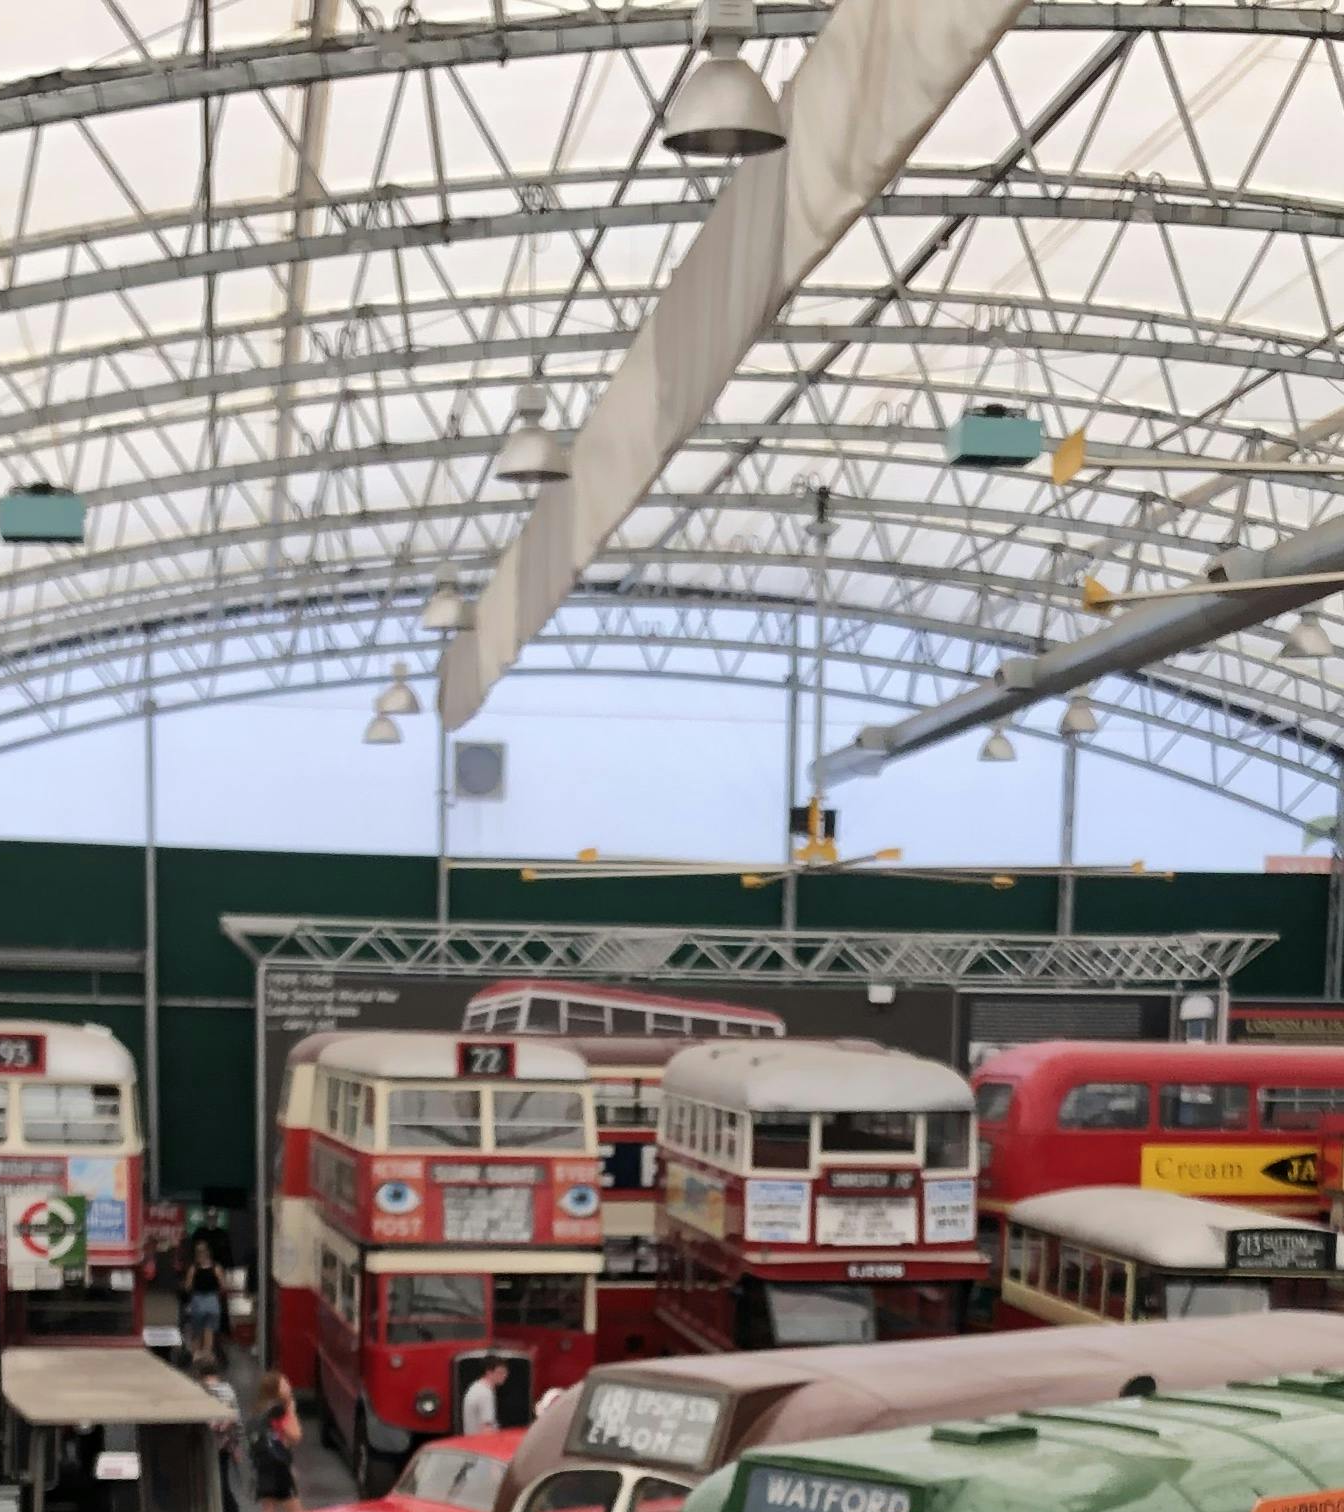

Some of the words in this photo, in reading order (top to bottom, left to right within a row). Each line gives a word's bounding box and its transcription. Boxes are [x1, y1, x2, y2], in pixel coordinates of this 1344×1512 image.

[470, 1048, 502, 1073] 22
[1156, 1156, 1244, 1181] Cream
[1237, 1234, 1261, 1256] 213
